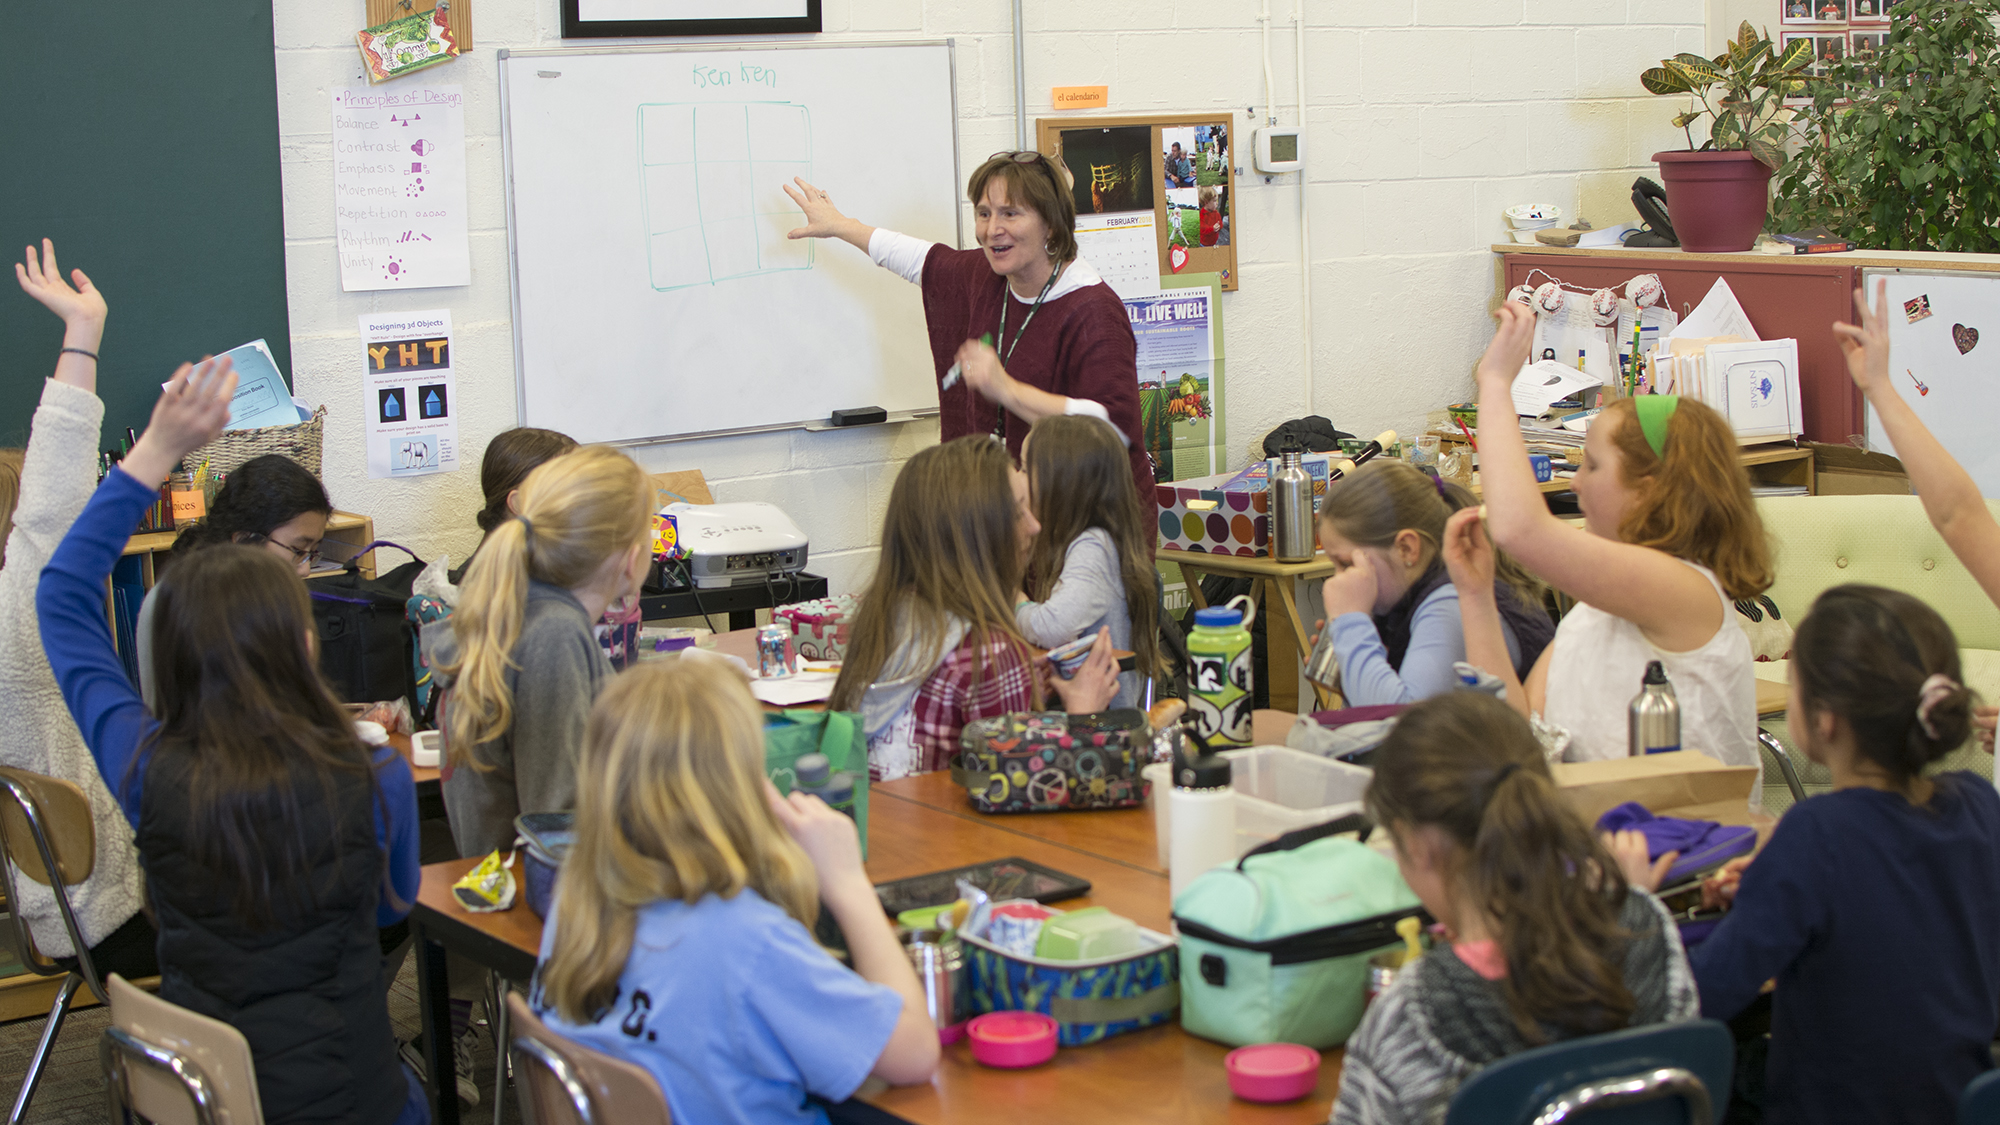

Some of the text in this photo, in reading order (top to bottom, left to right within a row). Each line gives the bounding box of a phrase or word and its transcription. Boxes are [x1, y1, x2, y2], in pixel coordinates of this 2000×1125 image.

[693, 60, 776, 89] Ken Ken
[344, 89, 462, 110] Principles of Design
[1058, 91, 1099, 101] el calendario
[336, 115, 379, 130] Balance
[337, 139, 401, 153] Contrast
[339, 161, 396, 178] Emphasis
[338, 184, 397, 198] Movement
[338, 206, 408, 223] Repetition
[1107, 217, 1139, 226] FEBRUARY
[341, 229, 391, 249] Rhythm
[342, 254, 374, 271] Unity
[1145, 304, 1172, 322] LIVE
[1174, 302, 1205, 320] WELL
[369, 319, 444, 332] Designing 3d Objects
[231, 384, 265, 402] position Book
[173, 501, 196, 514] pices
